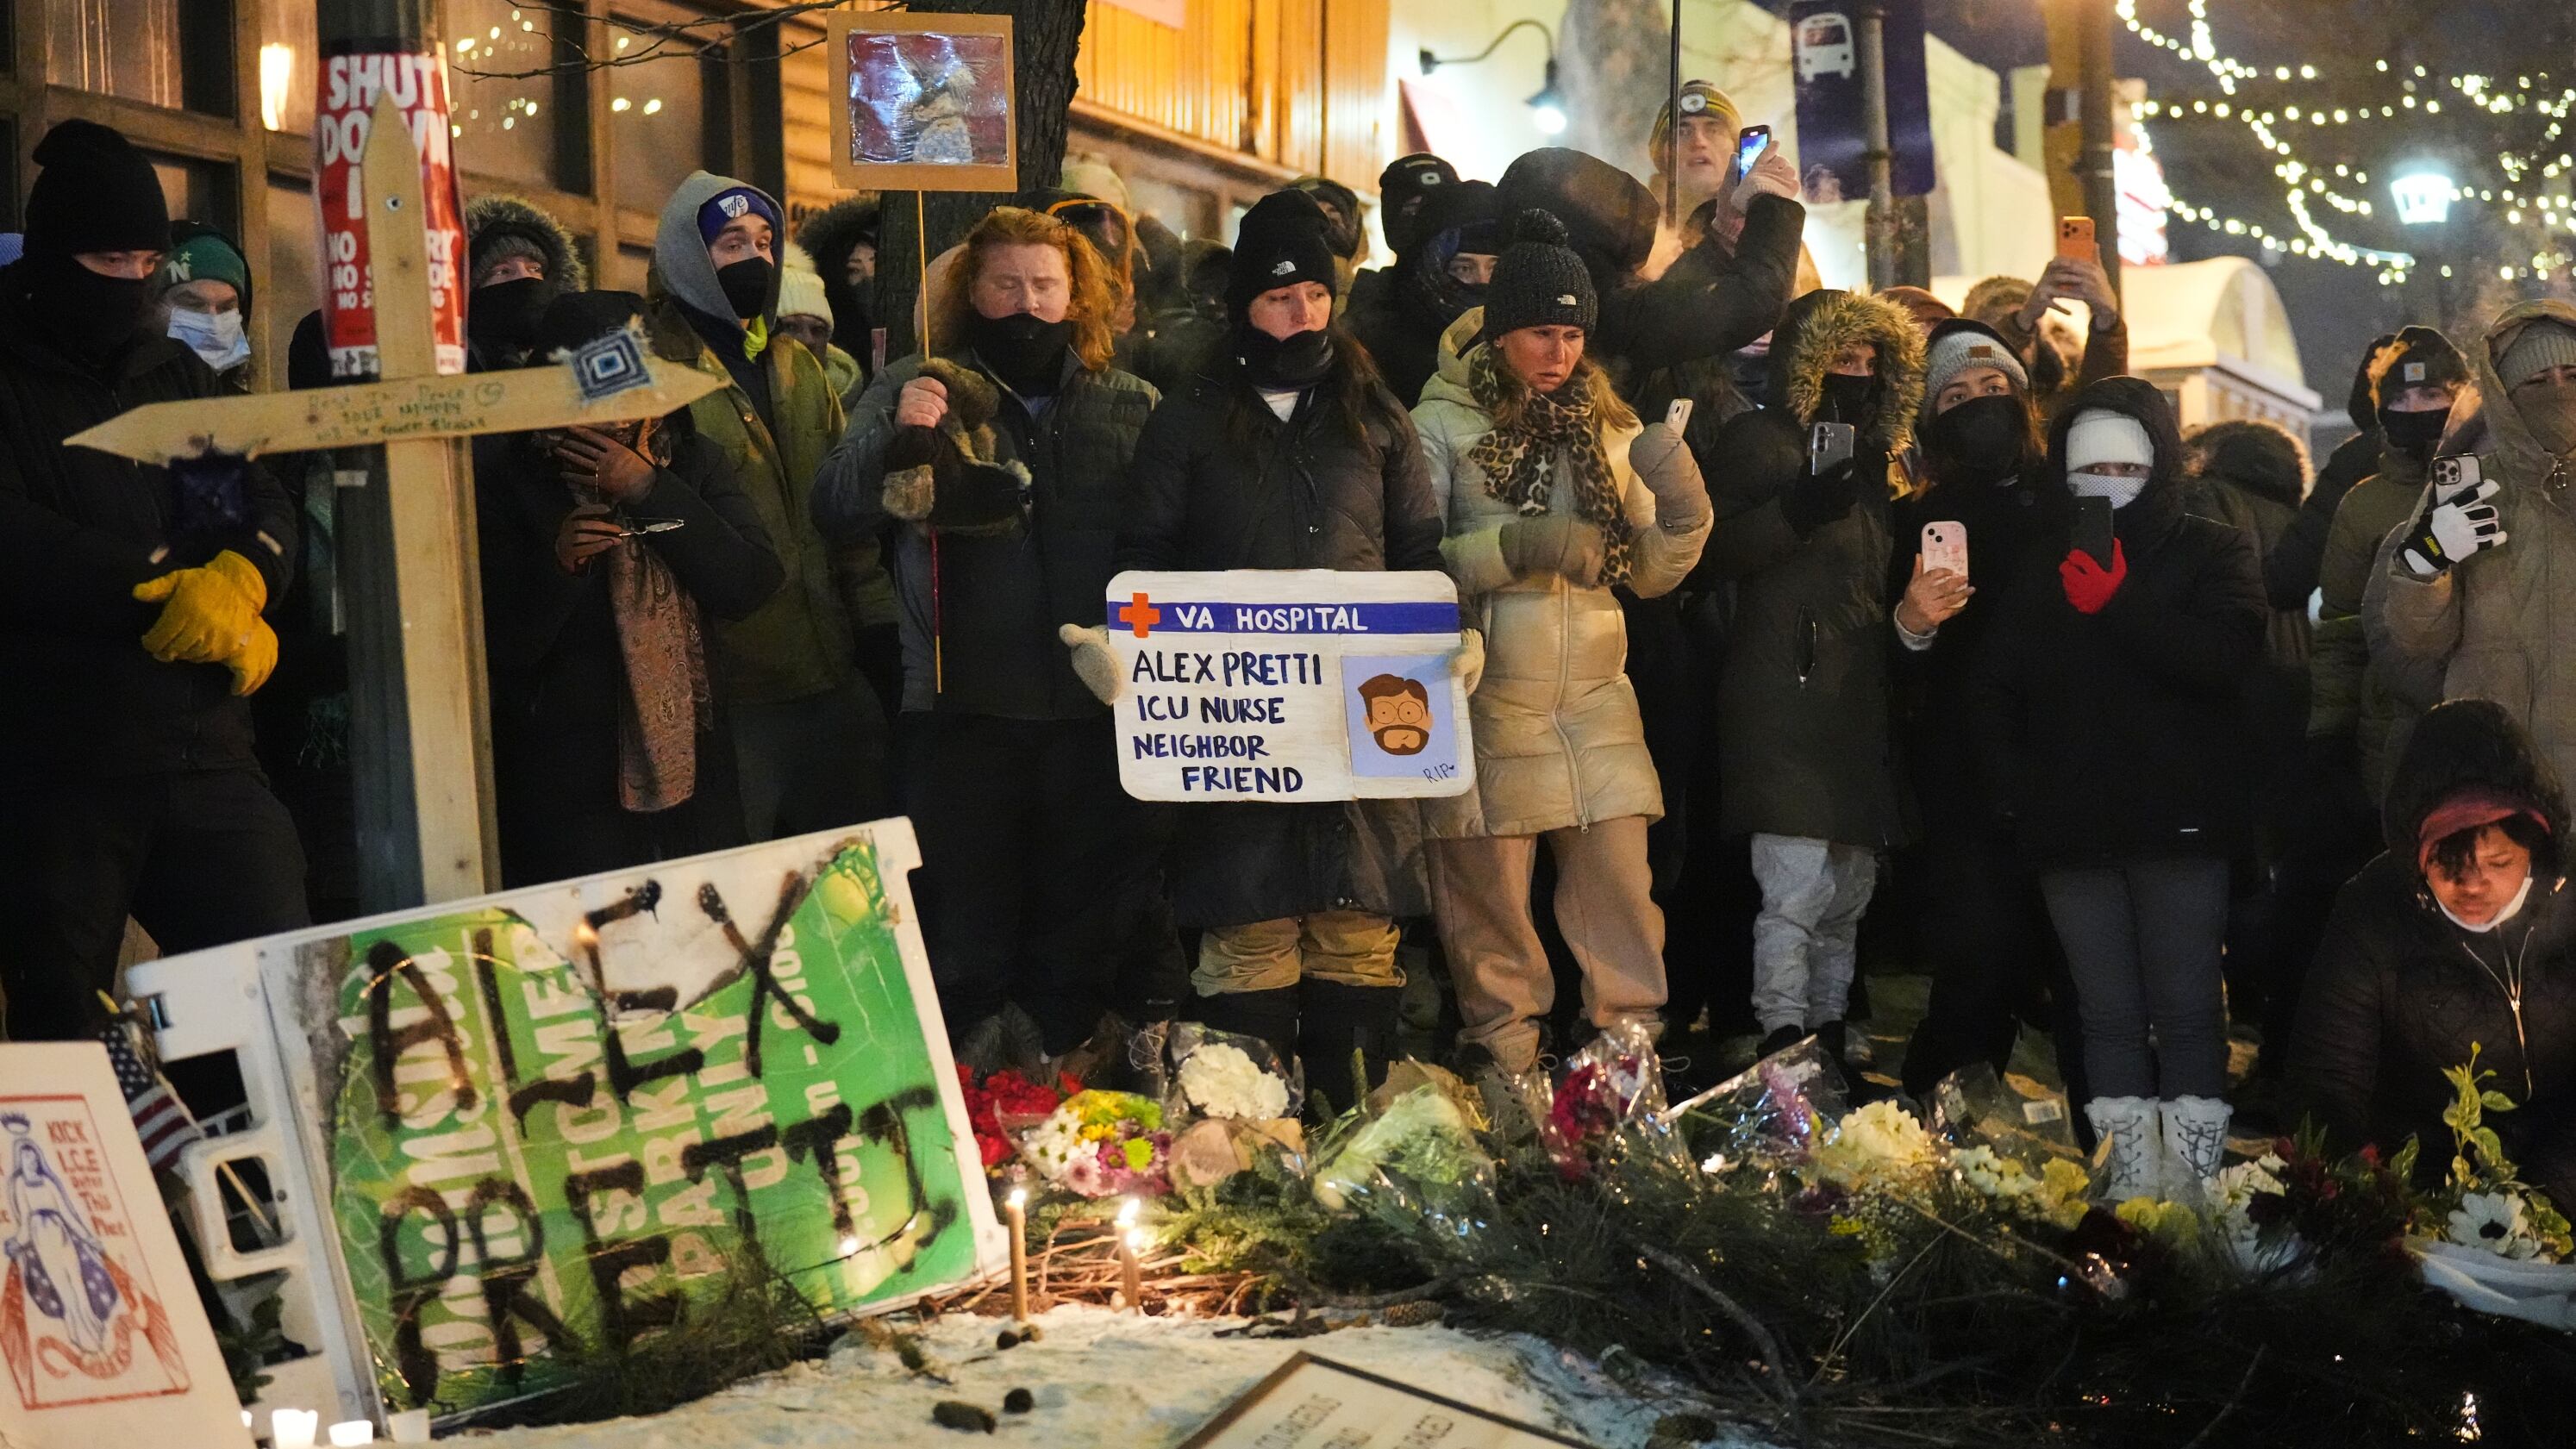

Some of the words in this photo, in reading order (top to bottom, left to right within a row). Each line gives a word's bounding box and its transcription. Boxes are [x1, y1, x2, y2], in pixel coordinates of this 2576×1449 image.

[328, 55, 437, 111] SHUT
[328, 230, 357, 262] NO
[1175, 606, 1215, 630] VA
[1236, 606, 1368, 632] HOSPITAL
[1132, 650, 1216, 684] ALEX
[1222, 651, 1322, 686] PRETTI
[1137, 695, 1189, 721] ICU
[1201, 696, 1285, 723] NURSE
[1133, 734, 1270, 761] NEIGHBOR
[1182, 766, 1304, 793] FRIEND
[1422, 763, 1448, 784] RIP
[367, 868, 841, 1132] ALEX
[608, 1009, 728, 1280] PARKN
[381, 1086, 957, 1407] PRETTI
